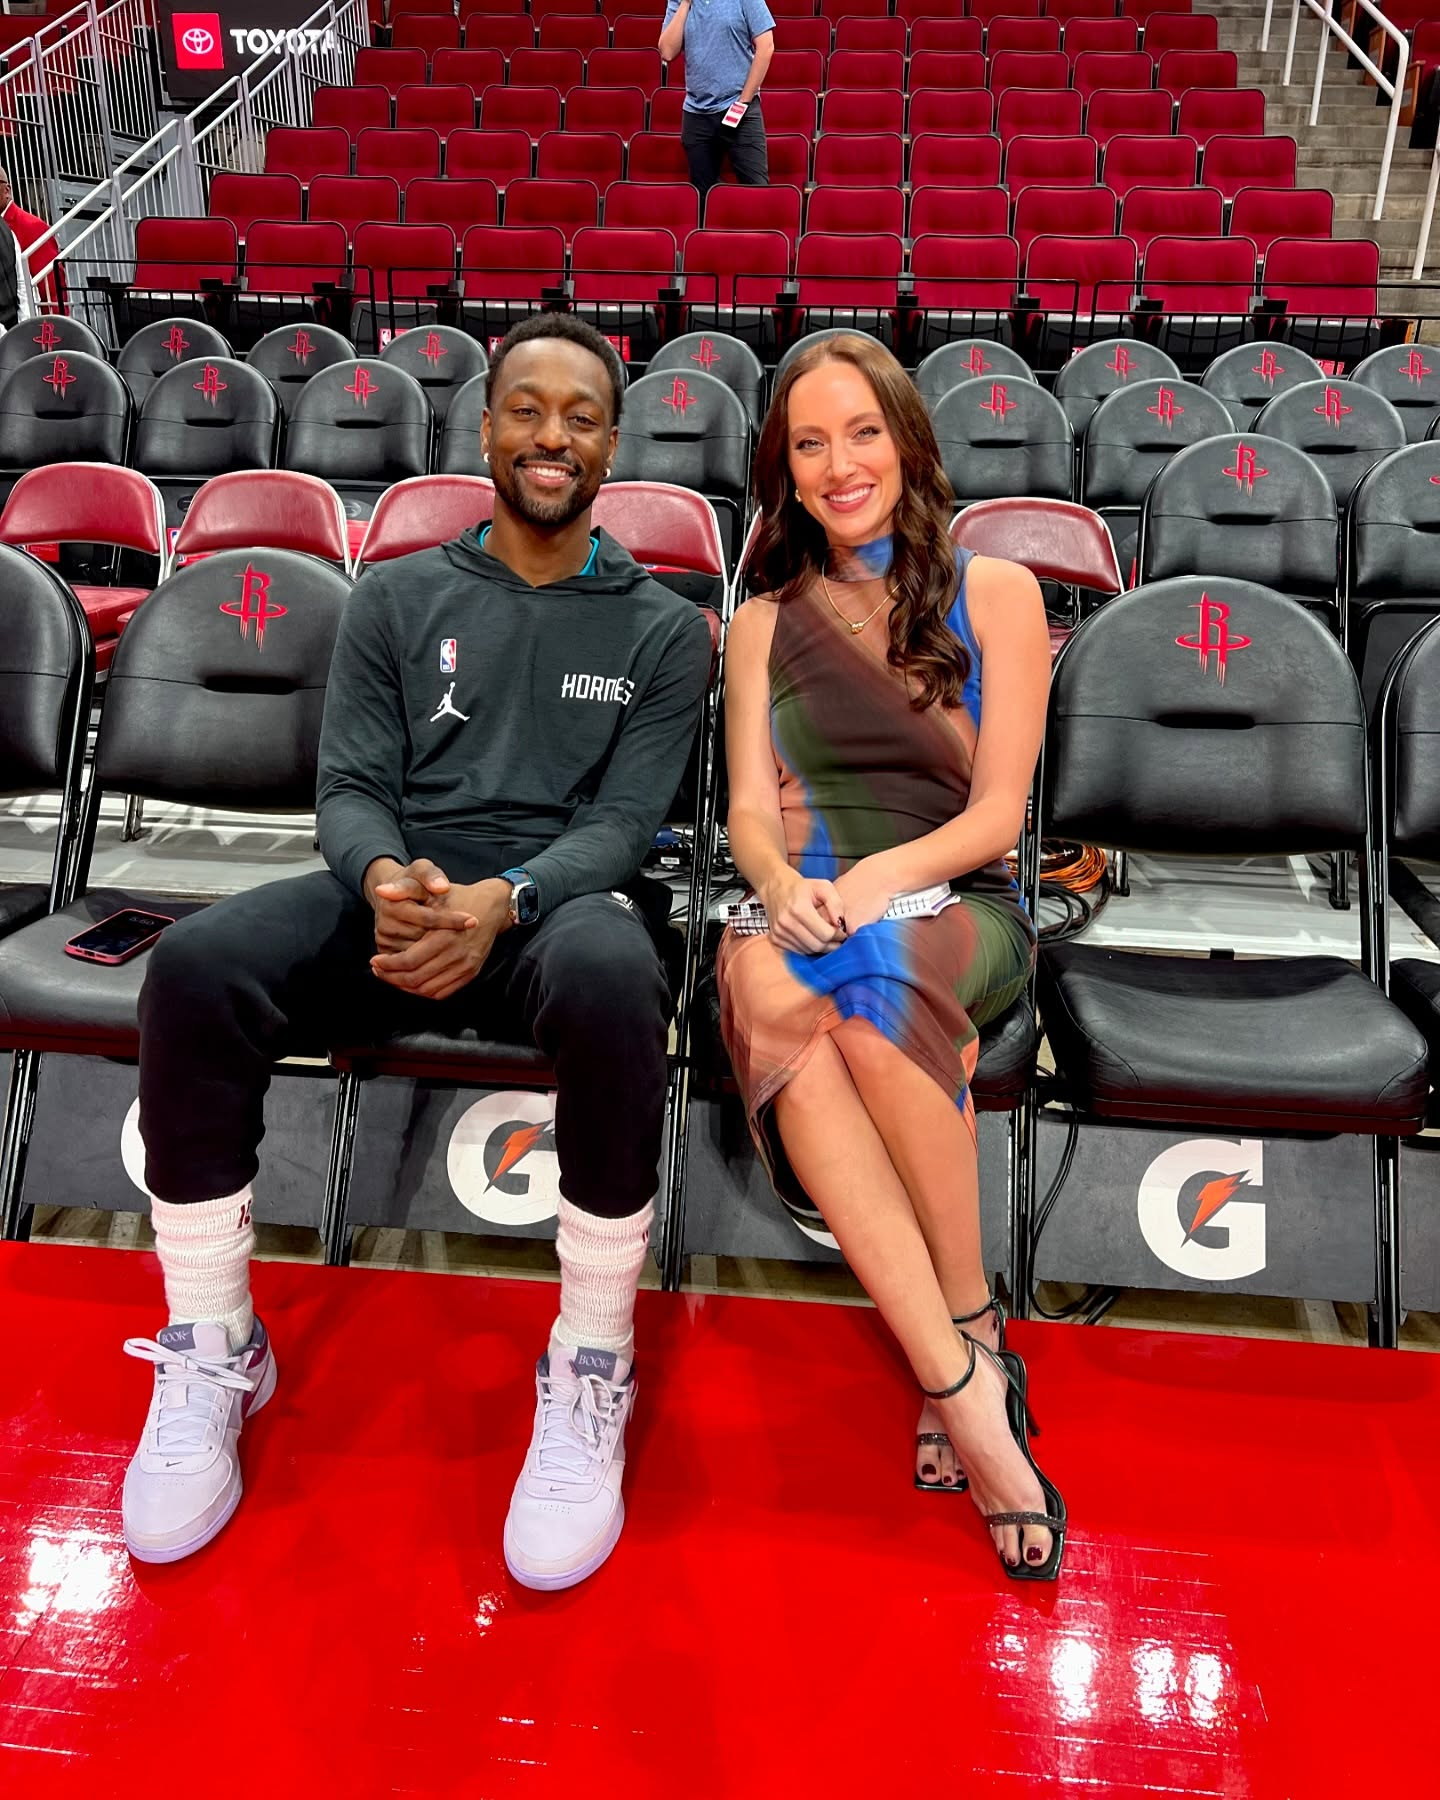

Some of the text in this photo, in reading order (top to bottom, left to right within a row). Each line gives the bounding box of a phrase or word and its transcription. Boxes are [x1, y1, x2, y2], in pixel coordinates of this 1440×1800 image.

[561, 673, 635, 706] HORNES
[1137, 1139, 1266, 1281] G
[161, 1332, 185, 1345] BOOK
[578, 1354, 608, 1370] BOOK
